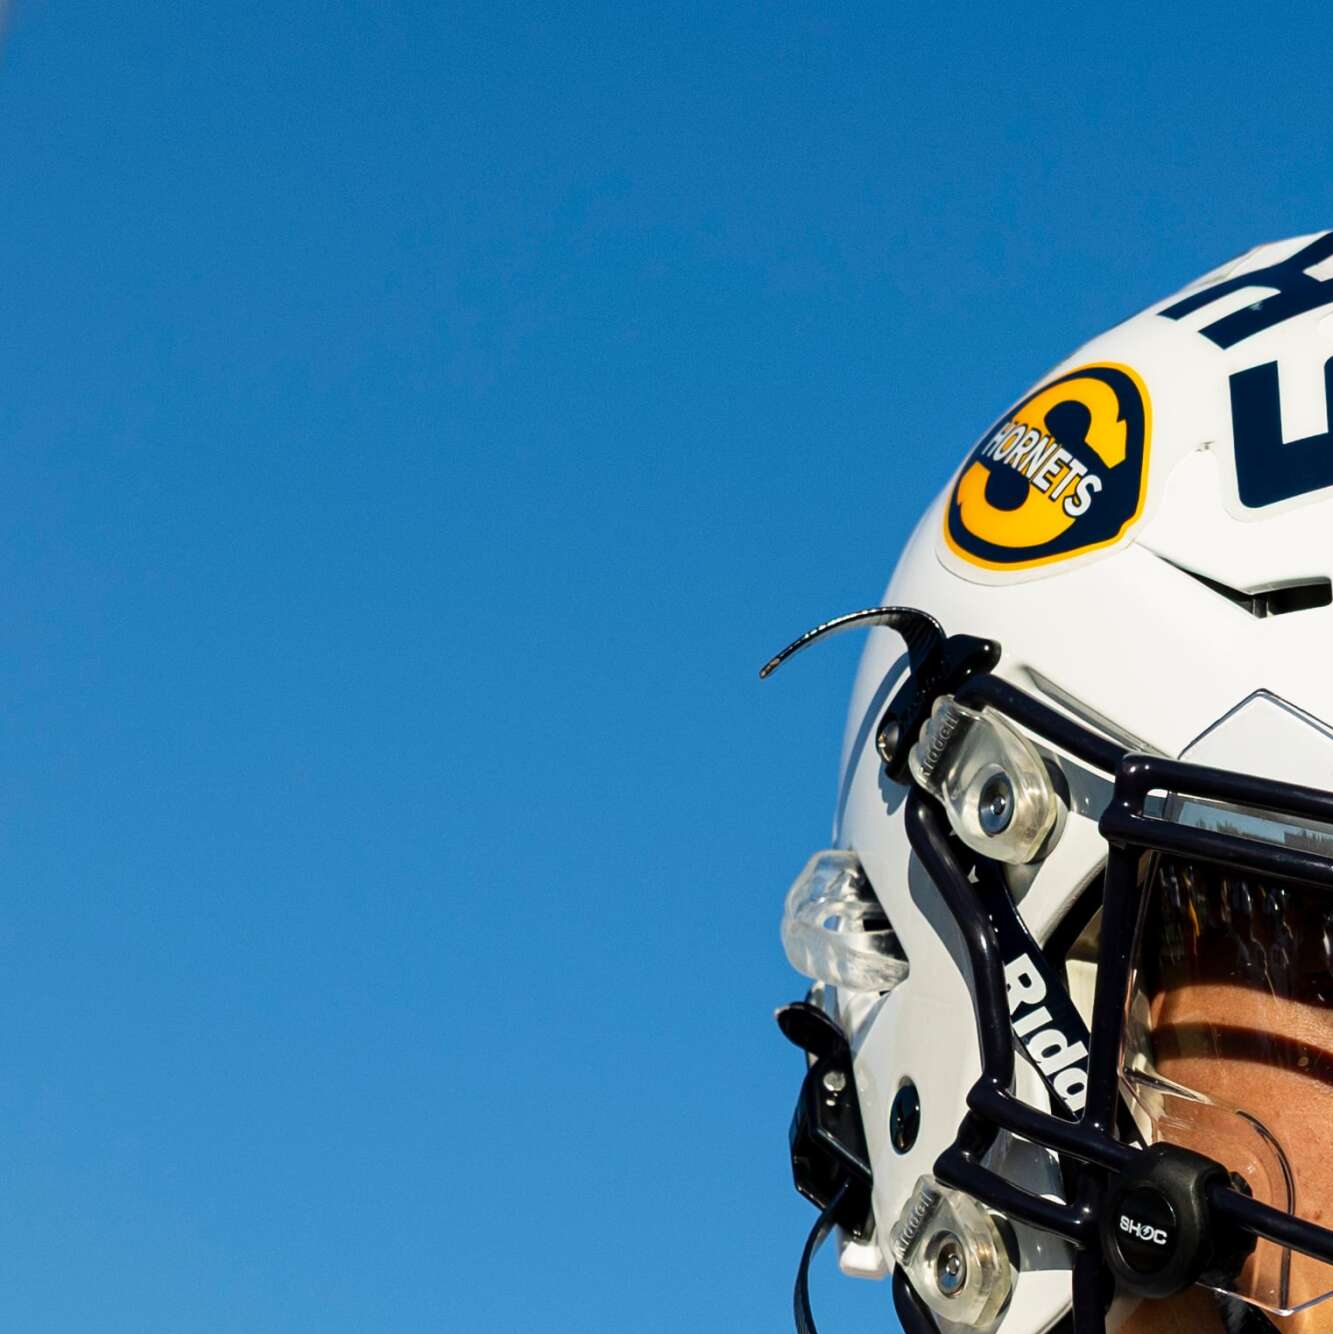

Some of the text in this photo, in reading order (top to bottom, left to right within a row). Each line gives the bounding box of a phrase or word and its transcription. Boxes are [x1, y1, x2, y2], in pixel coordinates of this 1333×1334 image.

[981, 421, 1102, 516] HORNETS
[1004, 953, 1088, 1112] Ridd
[1120, 1215, 1167, 1245] SHOC
